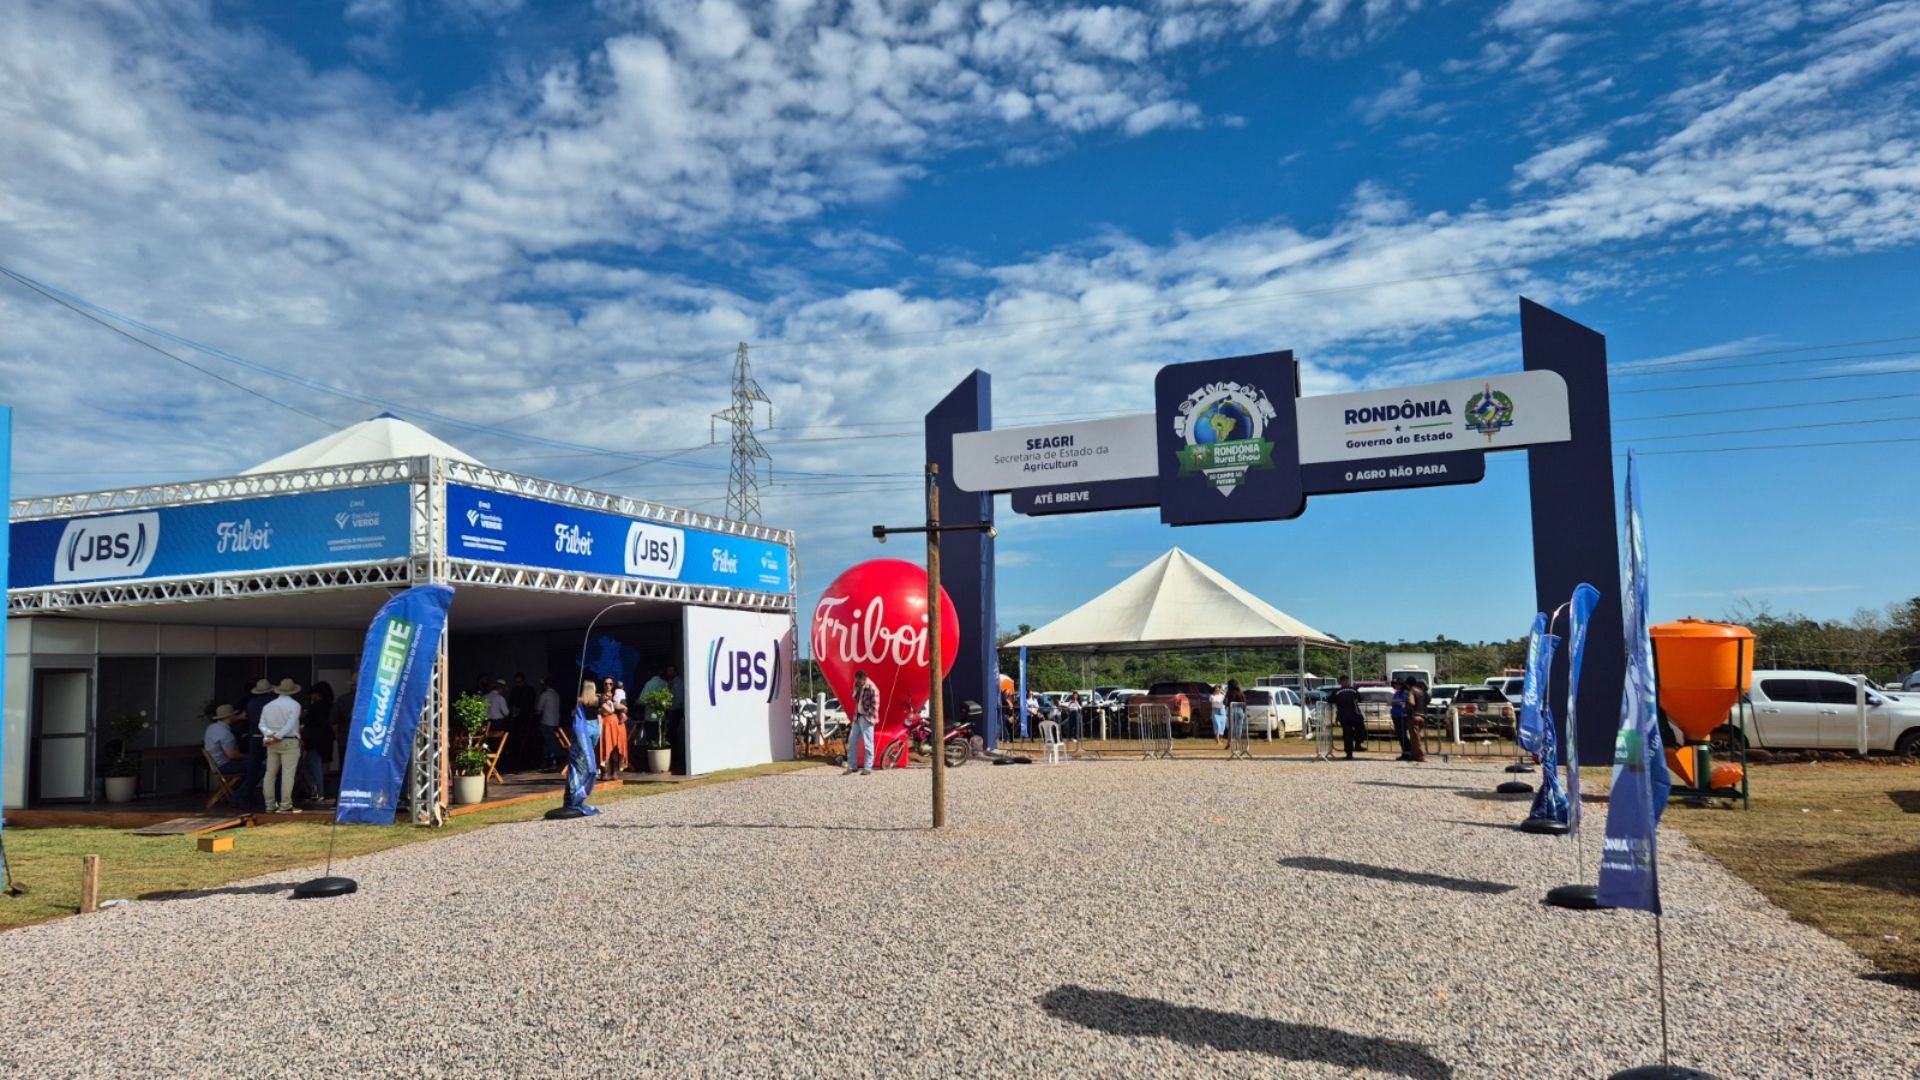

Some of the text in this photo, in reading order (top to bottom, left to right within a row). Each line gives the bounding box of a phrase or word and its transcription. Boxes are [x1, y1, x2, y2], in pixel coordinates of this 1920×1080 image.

[1344, 398, 1452, 425] RONDÔNIA
[1026, 435, 1074, 450] SEAGRI
[1345, 431, 1453, 449] Governo do Estado
[993, 445, 1109, 464] Secretaria de Estado da
[1214, 453, 1260, 464] Rural Show
[1023, 459, 1078, 472] Agricultura
[1344, 464, 1448, 481] O AGRO NÃO PARA
[1034, 491, 1090, 504] ATÉ BREVE
[216, 518, 271, 554] Friboi
[554, 523, 593, 556] Friboi
[815, 595, 930, 667] Friboi
[720, 651, 768, 693] JBS
